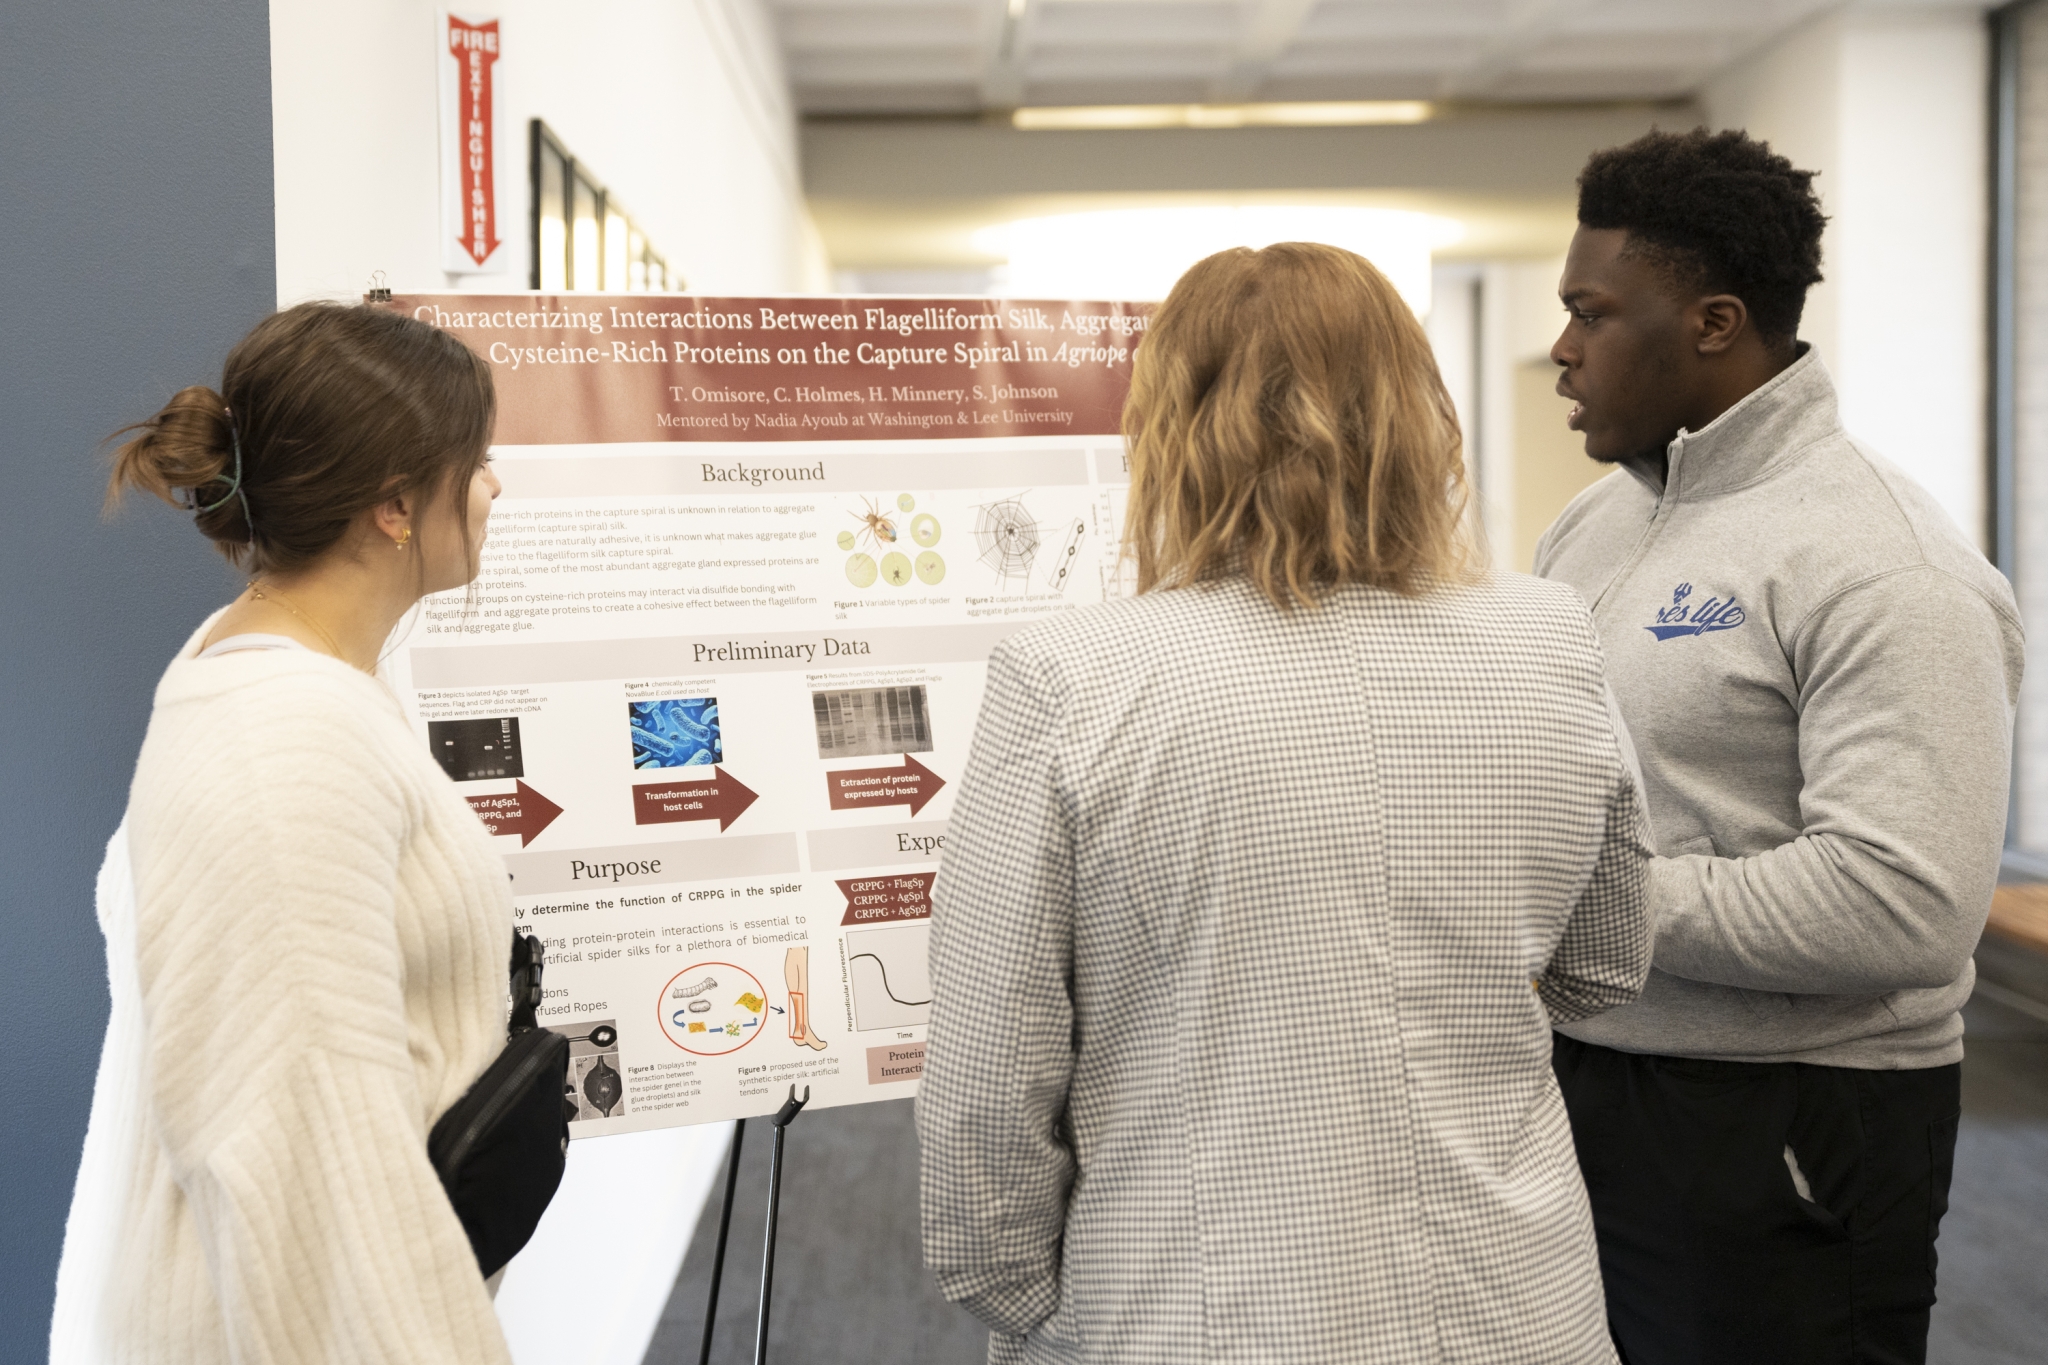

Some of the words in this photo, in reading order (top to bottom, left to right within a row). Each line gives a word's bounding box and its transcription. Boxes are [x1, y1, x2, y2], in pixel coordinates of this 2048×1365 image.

[450, 27, 499, 54] FIRE
[468, 50, 487, 259] EXTINGUISHER
[413, 306, 602, 334] Characterizing
[609, 307, 752, 329] Interactions
[758, 307, 858, 329] Between
[864, 307, 1002, 335] Flagelliform
[1009, 308, 1053, 333] Silk,
[1061, 308, 1151, 336] Aggregat
[489, 341, 668, 369] Cysteine-Rich
[673, 341, 770, 362] Proteins
[776, 347, 807, 362] on
[813, 340, 850, 362] the
[856, 340, 947, 368] Capture
[954, 339, 1020, 367] Spiral
[1026, 339, 1047, 361] in
[1052, 339, 1127, 367] Agriope
[668, 386, 687, 402] T.
[691, 386, 770, 404] Omisore,
[773, 385, 791, 401] C.
[794, 385, 864, 403] Holmes,
[868, 384, 887, 400] H.
[890, 384, 968, 404] Minnery,
[972, 384, 986, 399] S.
[989, 383, 1058, 403] Johnson
[656, 412, 728, 426] Mentored
[731, 412, 750, 429] by
[754, 411, 797, 425] Nadia
[800, 411, 848, 428] Ayoub
[852, 412, 865, 424] at
[867, 410, 953, 428] Washington
[956, 410, 968, 424] &
[972, 410, 998, 423] Lee
[1002, 409, 1073, 426] University
[701, 461, 824, 486] Background
[423, 594, 474, 604] Functional
[475, 595, 508, 605] groups
[524, 590, 585, 603] cysteine-rich
[587, 589, 626, 601] proteins
[628, 591, 647, 599] may
[649, 588, 685, 597] interact
[686, 586, 700, 595] via
[701, 585, 738, 595] disulfide
[740, 584, 776, 595] bonding
[776, 583, 795, 592] with
[425, 609, 479, 621] flagelliform
[483, 608, 501, 617] and
[503, 607, 549, 618] aggregate
[551, 604, 590, 616] proteins
[592, 605, 602, 613] to
[604, 603, 634, 612] create
[643, 601, 684, 611] cohesive
[685, 600, 712, 609] effect
[713, 599, 750, 608] between
[752, 598, 766, 607] the
[768, 596, 816, 608] flagelliform
[1656, 605, 1690, 624] res
[1690, 596, 1742, 636] life
[426, 624, 442, 633] silk
[443, 623, 462, 632] and
[464, 623, 510, 634] aggregate
[512, 621, 534, 632] glue.
[692, 640, 816, 662] Preliminary
[823, 637, 870, 656] Data
[840, 776, 881, 786] Extraction
[892, 774, 920, 785] protein
[644, 788, 709, 799] Transformation
[844, 788, 884, 799] expressed
[885, 788, 895, 797] by
[896, 787, 918, 795] hosts
[491, 798, 519, 808] AgSp1,
[663, 803, 682, 811] host
[683, 802, 702, 810] cells
[478, 811, 504, 819] RPPG,
[505, 810, 521, 818] and
[896, 833, 946, 854] Expe
[570, 859, 661, 882] Purpose
[850, 880, 884, 892] CRPPG
[894, 878, 924, 890] FlagSp
[531, 901, 589, 915] determine
[595, 899, 613, 909] the
[619, 895, 665, 907] function
[671, 892, 682, 903] of
[688, 889, 724, 901] CRPPG
[730, 888, 740, 898] in
[746, 886, 763, 896] the
[769, 883, 802, 896] spider
[853, 894, 888, 905] CRPPG
[854, 907, 888, 919] CRPPG
[898, 905, 927, 918] AgSp2
[572, 929, 655, 948] protein-protein
[661, 924, 724, 937] interactions
[744, 916, 789, 929] essential
[795, 916, 806, 925] to
[543, 952, 582, 964] rtificial
[587, 949, 621, 962] spider
[627, 946, 650, 957] silks
[654, 944, 670, 954] for
[687, 939, 732, 953] plethora
[736, 936, 746, 946] of
[752, 930, 808, 945] biomedical
[838, 938, 848, 983] Fluorescence
[536, 1002, 570, 1014] nfused
[573, 1002, 607, 1012] Ropes
[844, 984, 853, 1032] Perpendicular
[888, 1049, 924, 1060] Protein
[627, 1066, 648, 1074] Figure
[657, 1063, 684, 1071] Displays
[737, 1067, 760, 1075] Figure
[769, 1061, 802, 1072] proposed
[881, 1064, 923, 1076] Interacti
[628, 1073, 664, 1082] interaction
[738, 1075, 771, 1086] synthetic
[772, 1073, 795, 1082] spider
[811, 1067, 839, 1077] artificial
[642, 1084, 662, 1092] spider
[739, 1088, 768, 1096] tendons
[630, 1095, 644, 1103] glue
[676, 1090, 689, 1098] and
[690, 1089, 701, 1097] silk
[653, 1102, 674, 1111] spider
[675, 1100, 689, 1108] web
